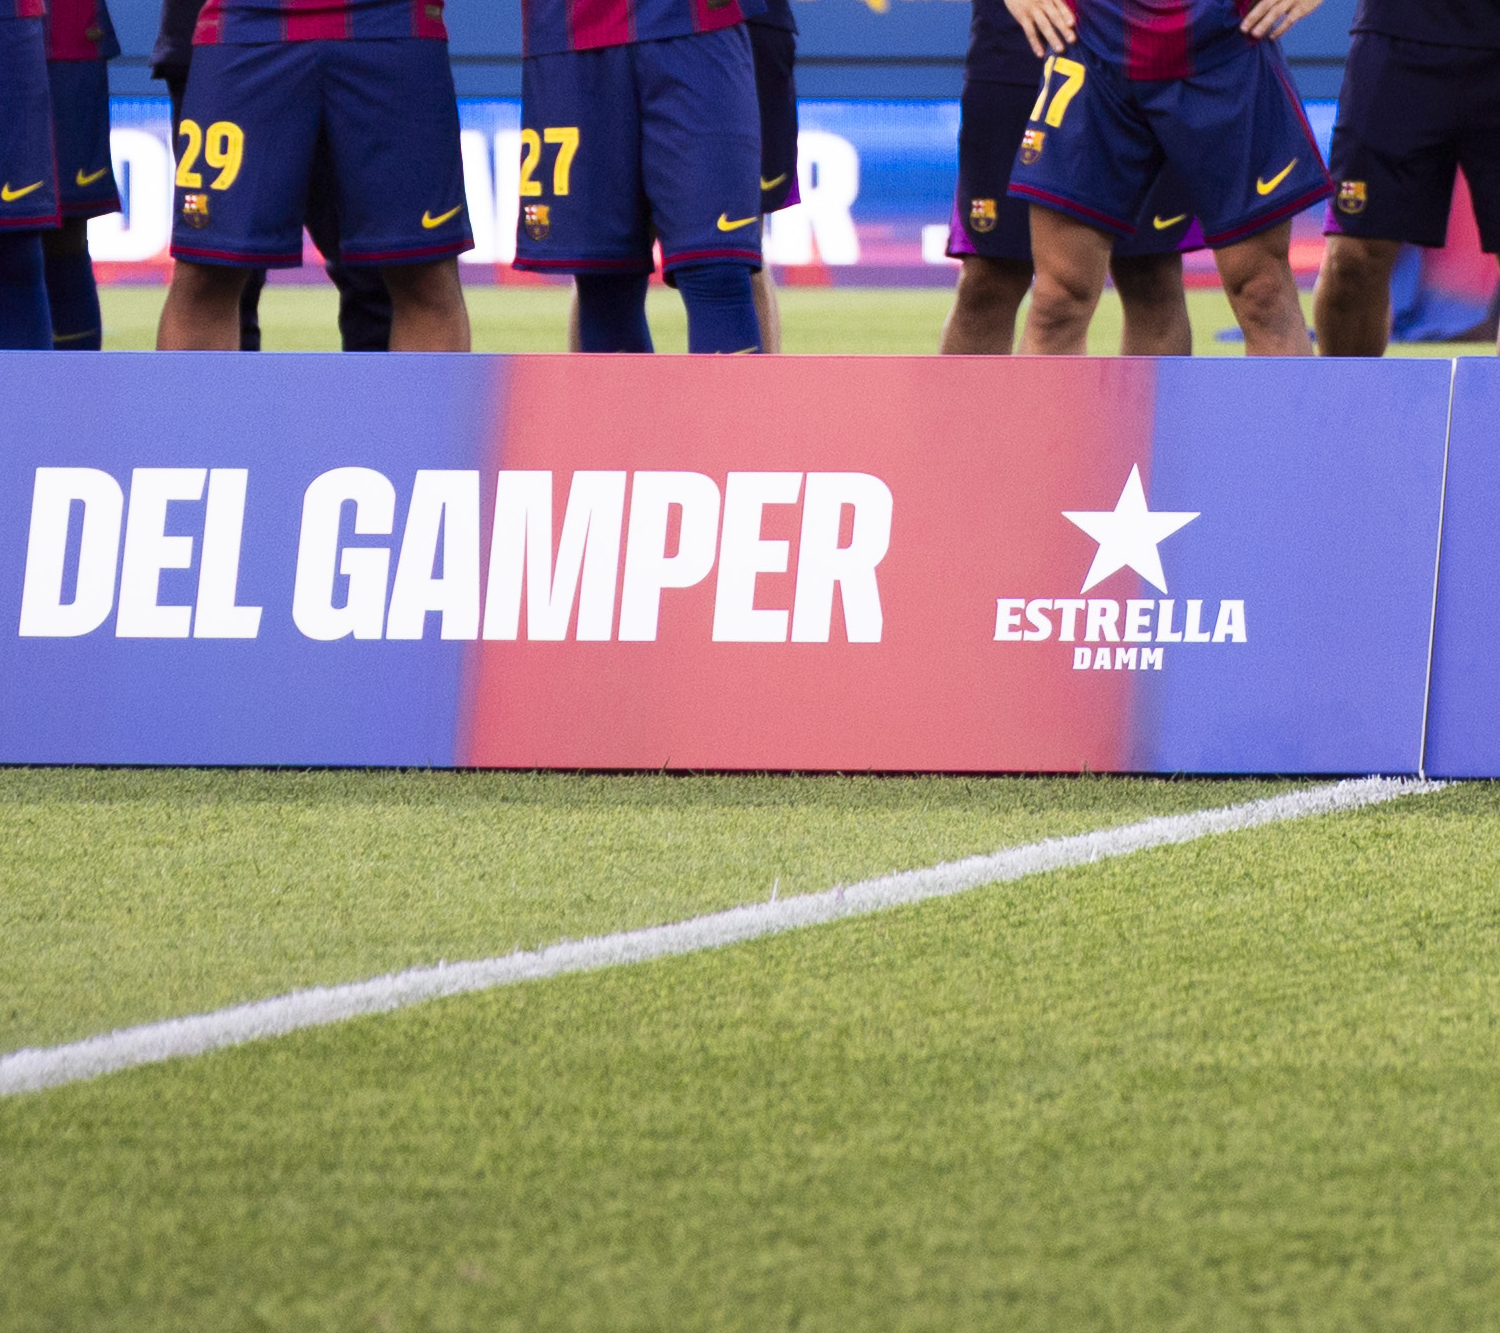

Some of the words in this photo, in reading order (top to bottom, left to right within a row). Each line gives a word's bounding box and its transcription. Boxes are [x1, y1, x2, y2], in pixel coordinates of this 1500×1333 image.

[175, 119, 244, 190] 29
[519, 127, 579, 197] 27
[19, 466, 263, 638] DEL
[292, 466, 894, 643] GAMPER
[993, 598, 1248, 643] ESTRELLA
[1072, 647, 1164, 671] DAMM
